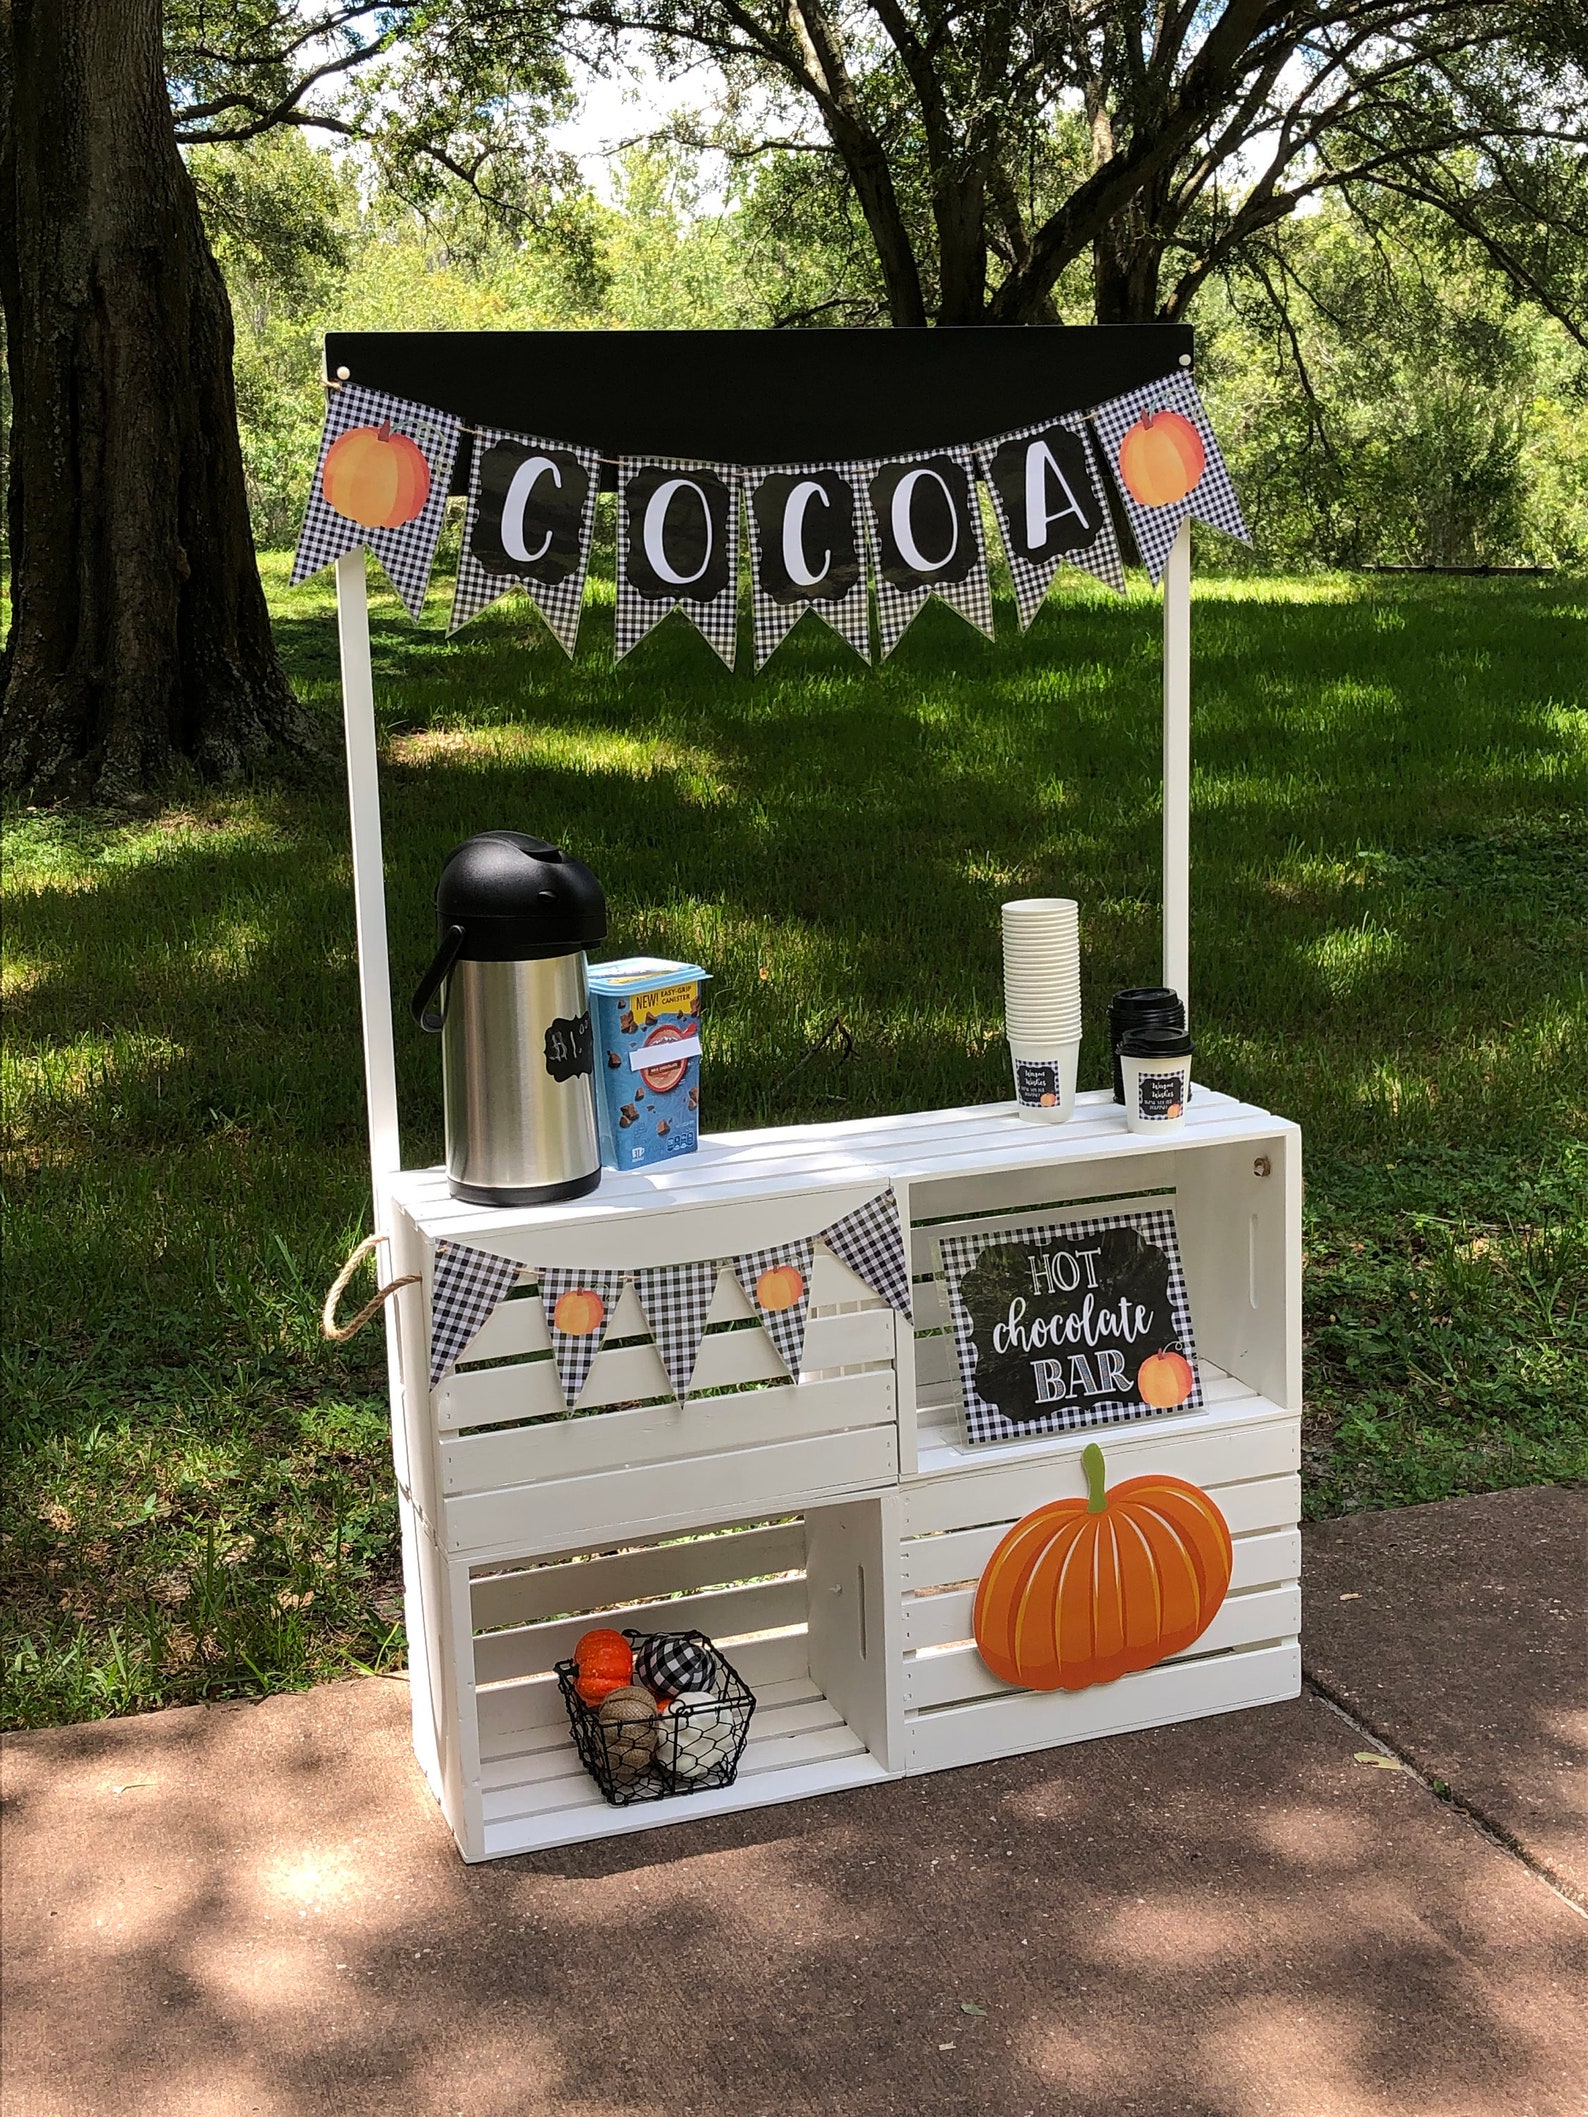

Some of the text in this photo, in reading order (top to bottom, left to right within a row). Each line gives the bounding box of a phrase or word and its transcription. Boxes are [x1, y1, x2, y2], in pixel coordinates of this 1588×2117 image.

[501, 440, 1089, 586] COCOA
[636, 992, 659, 1011] NEW!
[660, 985, 692, 998] EASY-GRIP
[662, 993, 691, 1005] CANISTER
[1028, 1247, 1101, 1296] HOT
[993, 1293, 1154, 1354] chocolate
[1030, 1350, 1134, 1404] BAR
